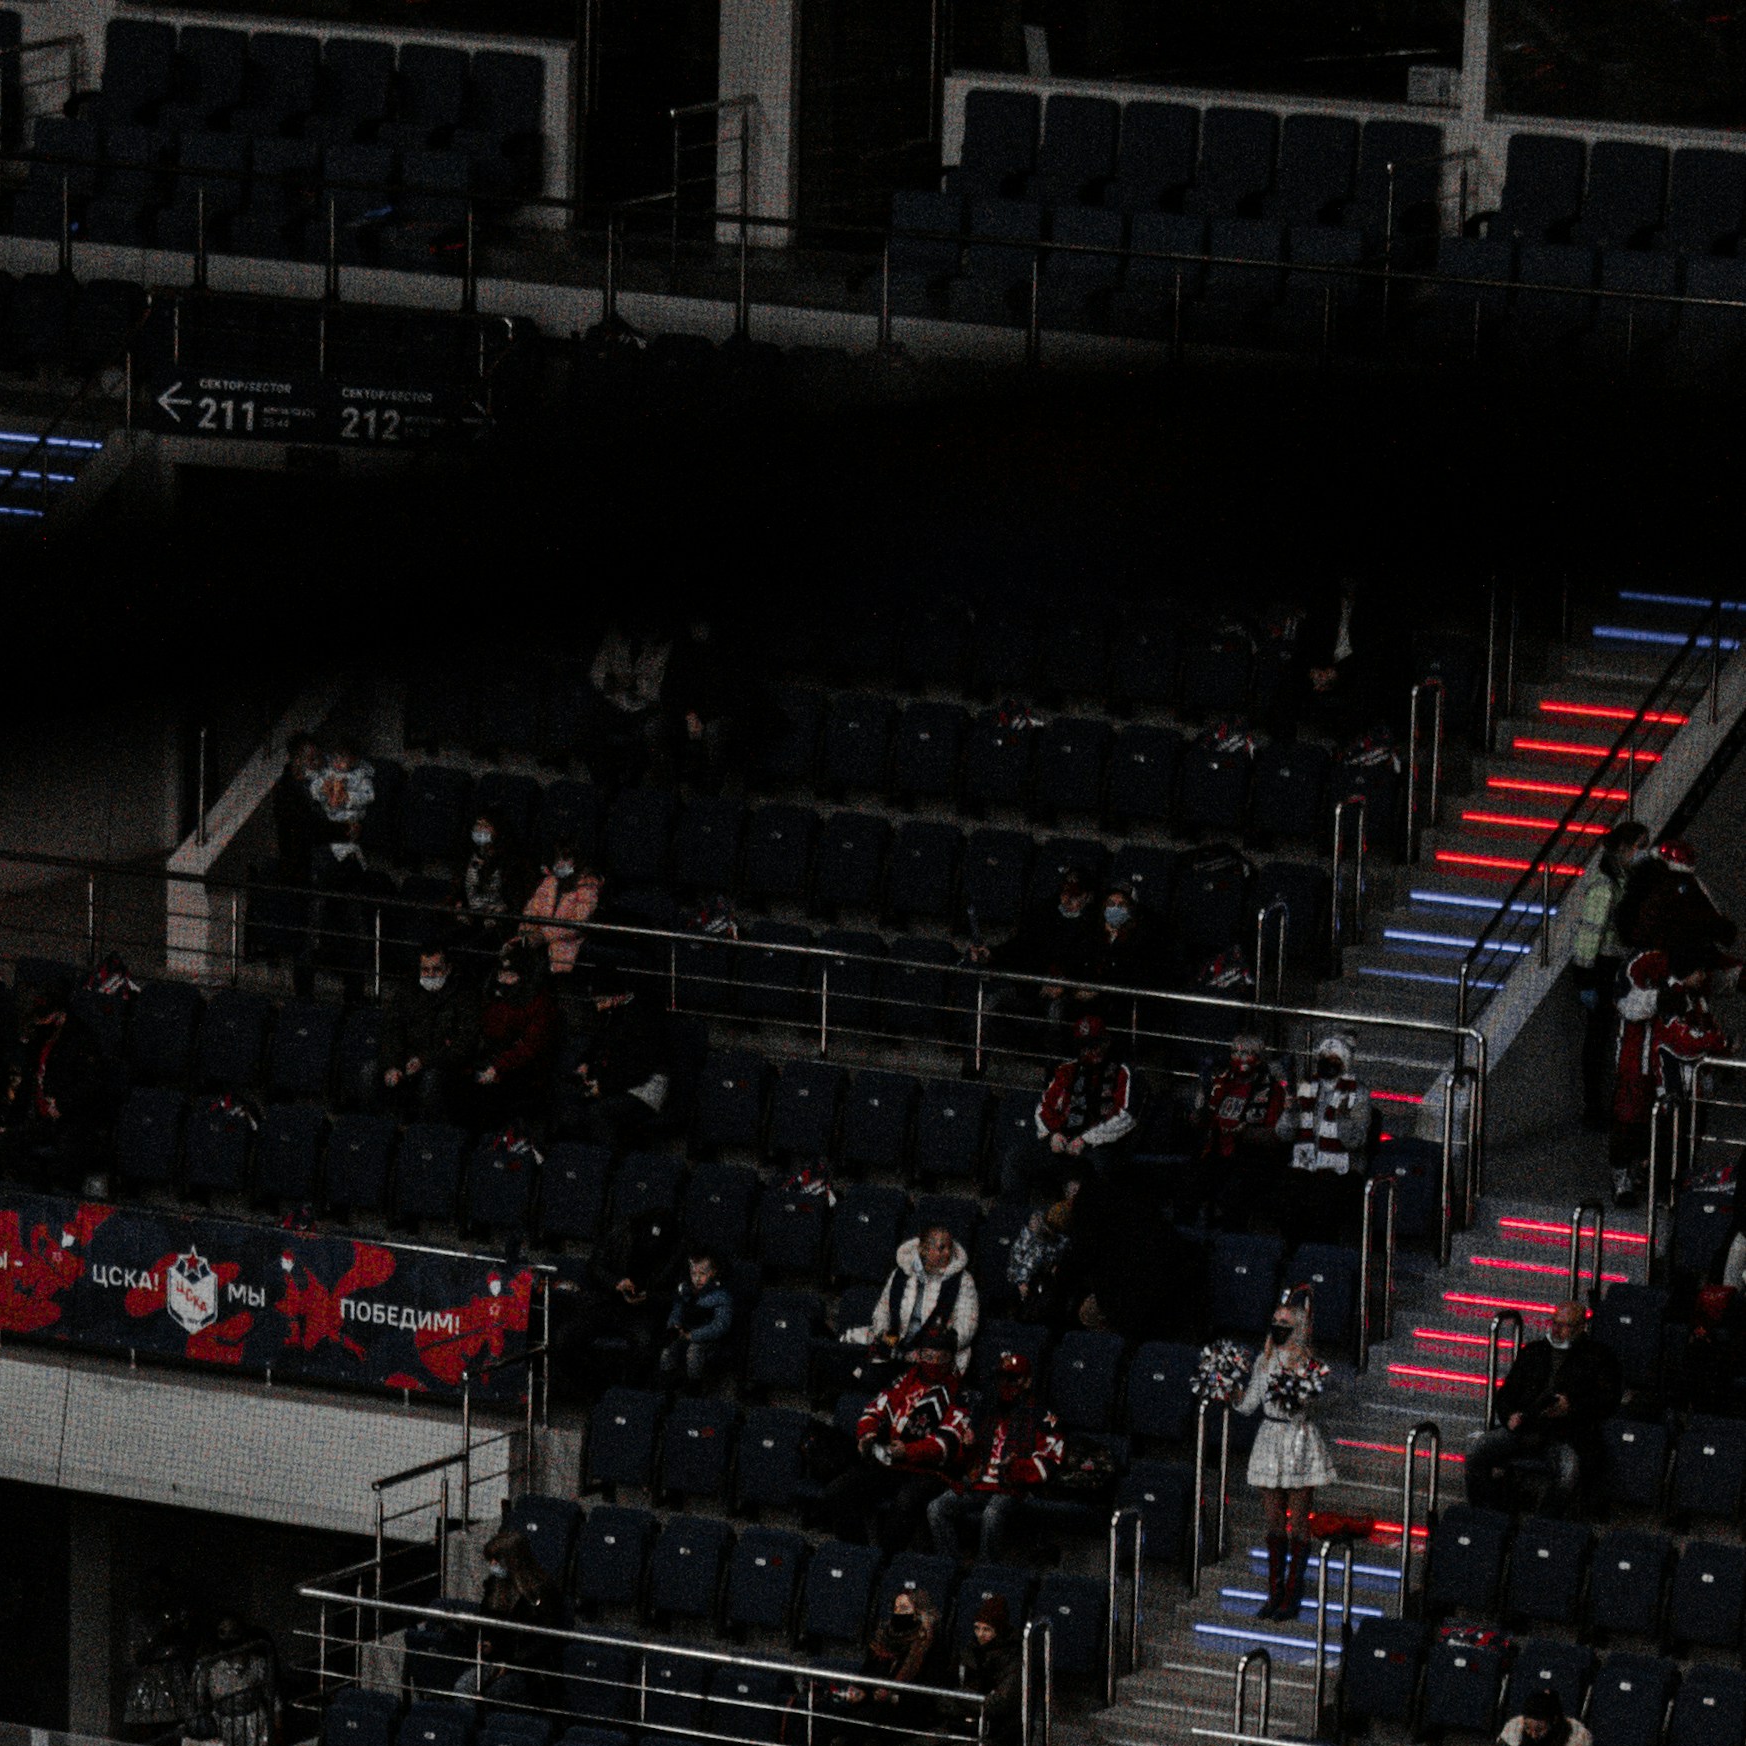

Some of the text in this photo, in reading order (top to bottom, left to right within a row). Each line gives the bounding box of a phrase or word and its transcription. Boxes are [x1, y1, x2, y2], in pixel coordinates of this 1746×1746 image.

[197, 398, 255, 431] 211
[340, 406, 401, 441] 212
[92, 1262, 160, 1294] ЦСКА!
[227, 1282, 266, 1309] МЫ
[340, 1297, 461, 1337] ПОБЕДИМ!
